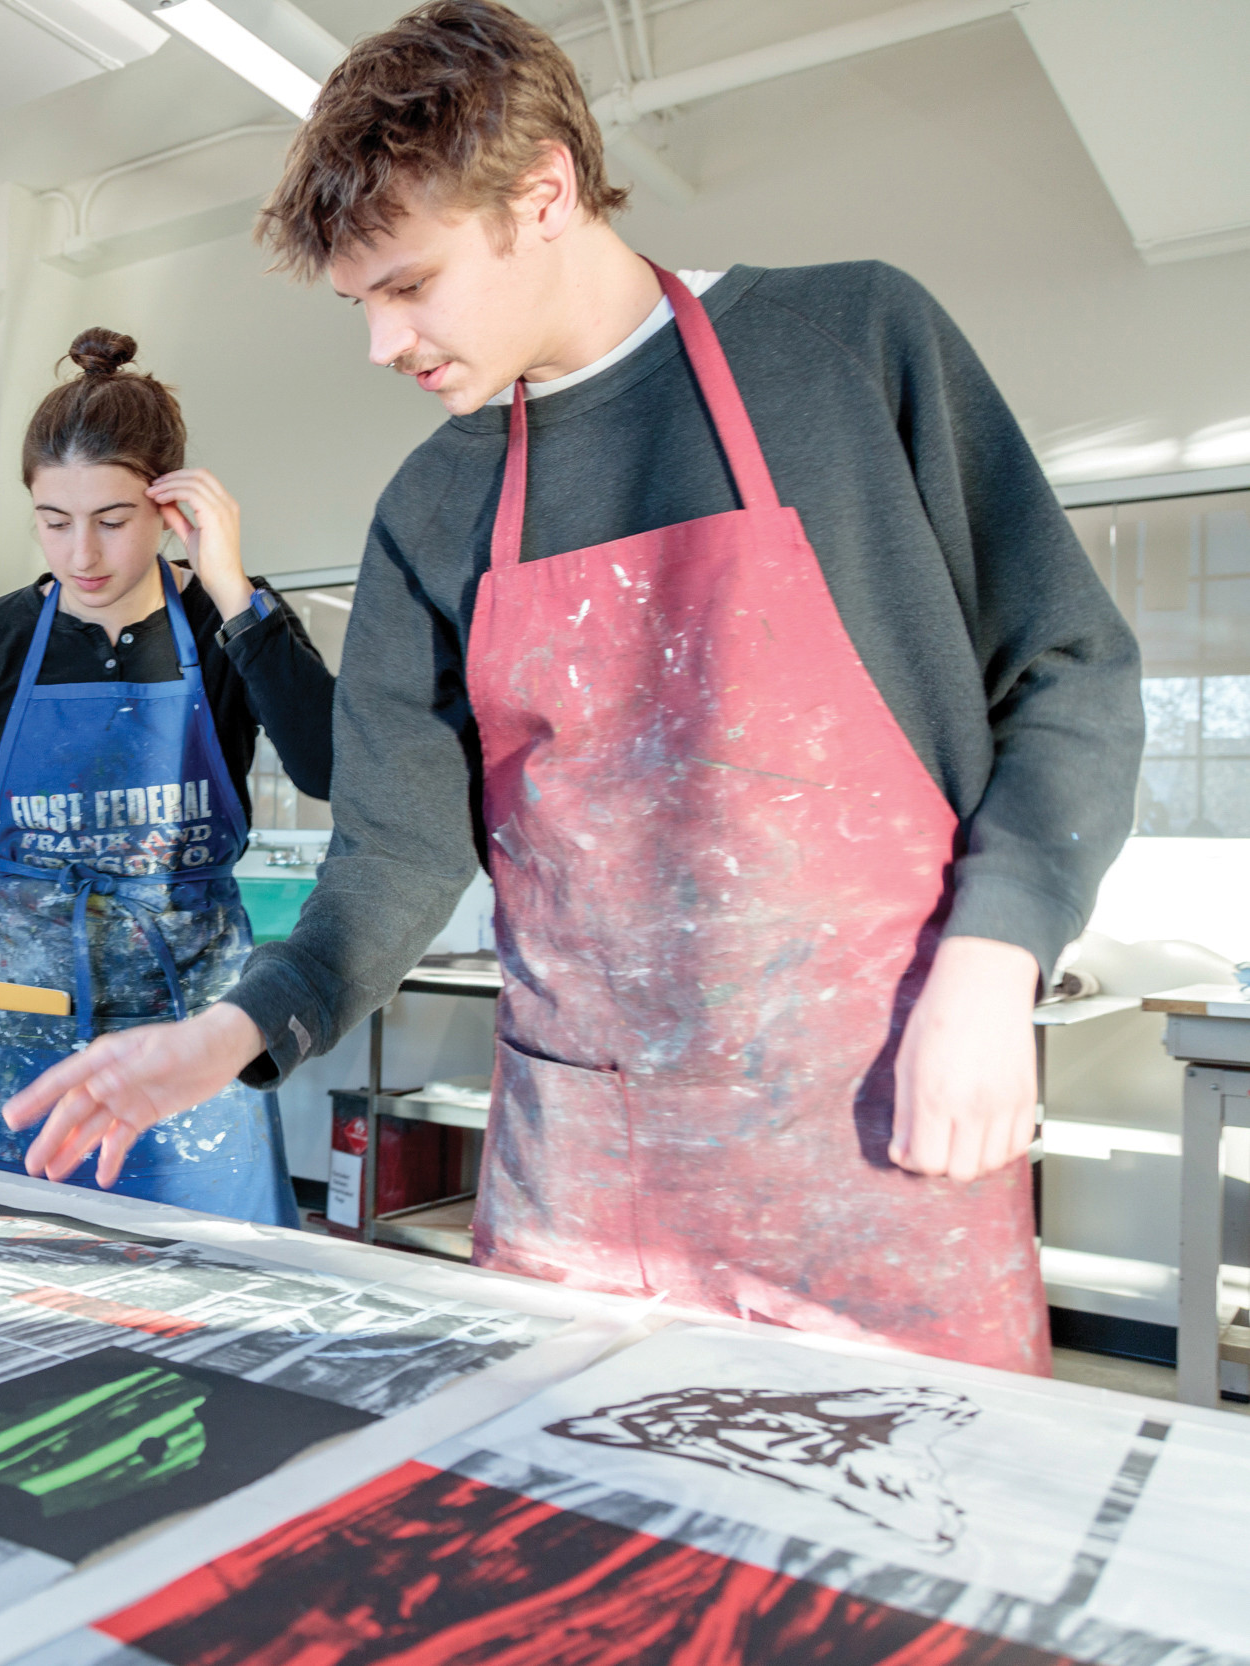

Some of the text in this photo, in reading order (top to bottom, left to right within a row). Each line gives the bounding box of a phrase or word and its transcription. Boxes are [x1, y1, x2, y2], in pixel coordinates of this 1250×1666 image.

[11, 780, 212, 833] FIRST FEDERAL
[21, 825, 212, 855] FRANK AND
